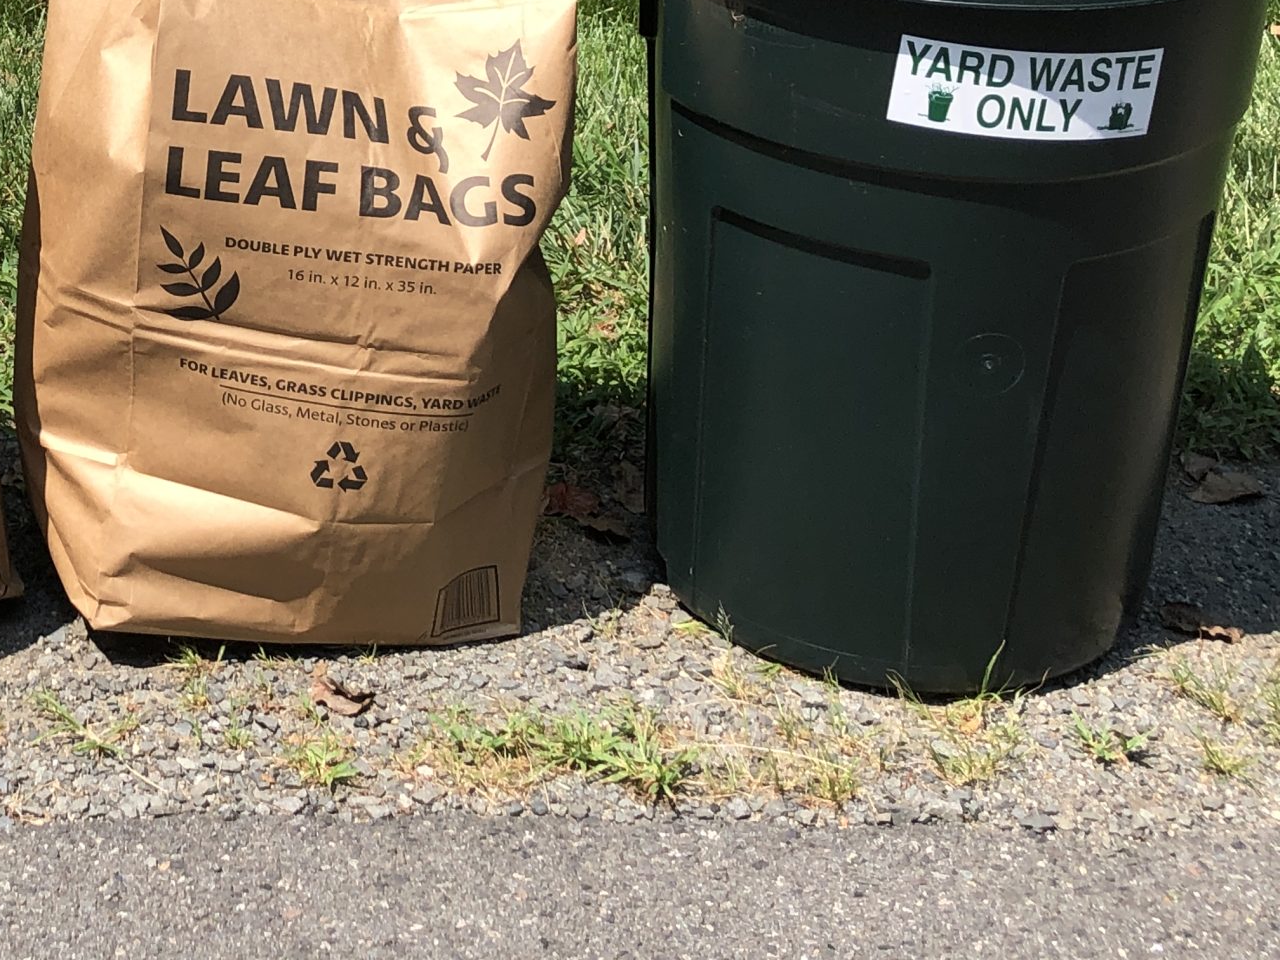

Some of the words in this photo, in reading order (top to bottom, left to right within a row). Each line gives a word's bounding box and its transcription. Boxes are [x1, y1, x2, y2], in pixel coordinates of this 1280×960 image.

[906, 40, 1015, 88] YARD
[1029, 54, 1156, 93] WASTE
[171, 69, 389, 145] LAWN
[407, 105, 449, 174] &
[976, 94, 1083, 133] ONLY
[165, 145, 339, 212] LEAF
[358, 164, 537, 228] BAGS
[224, 236, 290, 256] DOUBLE
[293, 245, 322, 260] PLY
[325, 248, 363, 265] WET
[365, 252, 451, 273] STRENGTH
[453, 261, 502, 276] PAPER
[288, 268, 305, 282] 16
[308, 270, 327, 285] in.
[330, 276, 339, 286] x
[344, 274, 360, 288] 12
[364, 276, 382, 291] in.
[385, 281, 394, 291] x
[398, 280, 416, 294] 35
[419, 281, 437, 295] in.
[179, 357, 208, 376] FOR
[211, 366, 272, 390] LEAVES,
[275, 378, 327, 398] GRASS
[330, 388, 418, 411] CLIPPINGS,
[421, 397, 464, 410] YARD
[221, 390, 248, 409] (No
[251, 397, 292, 419] Glass,
[296, 406, 343, 427] Metal,
[346, 414, 396, 431] Stones
[400, 420, 416, 432] or
[419, 419, 469, 432] Plastic)
